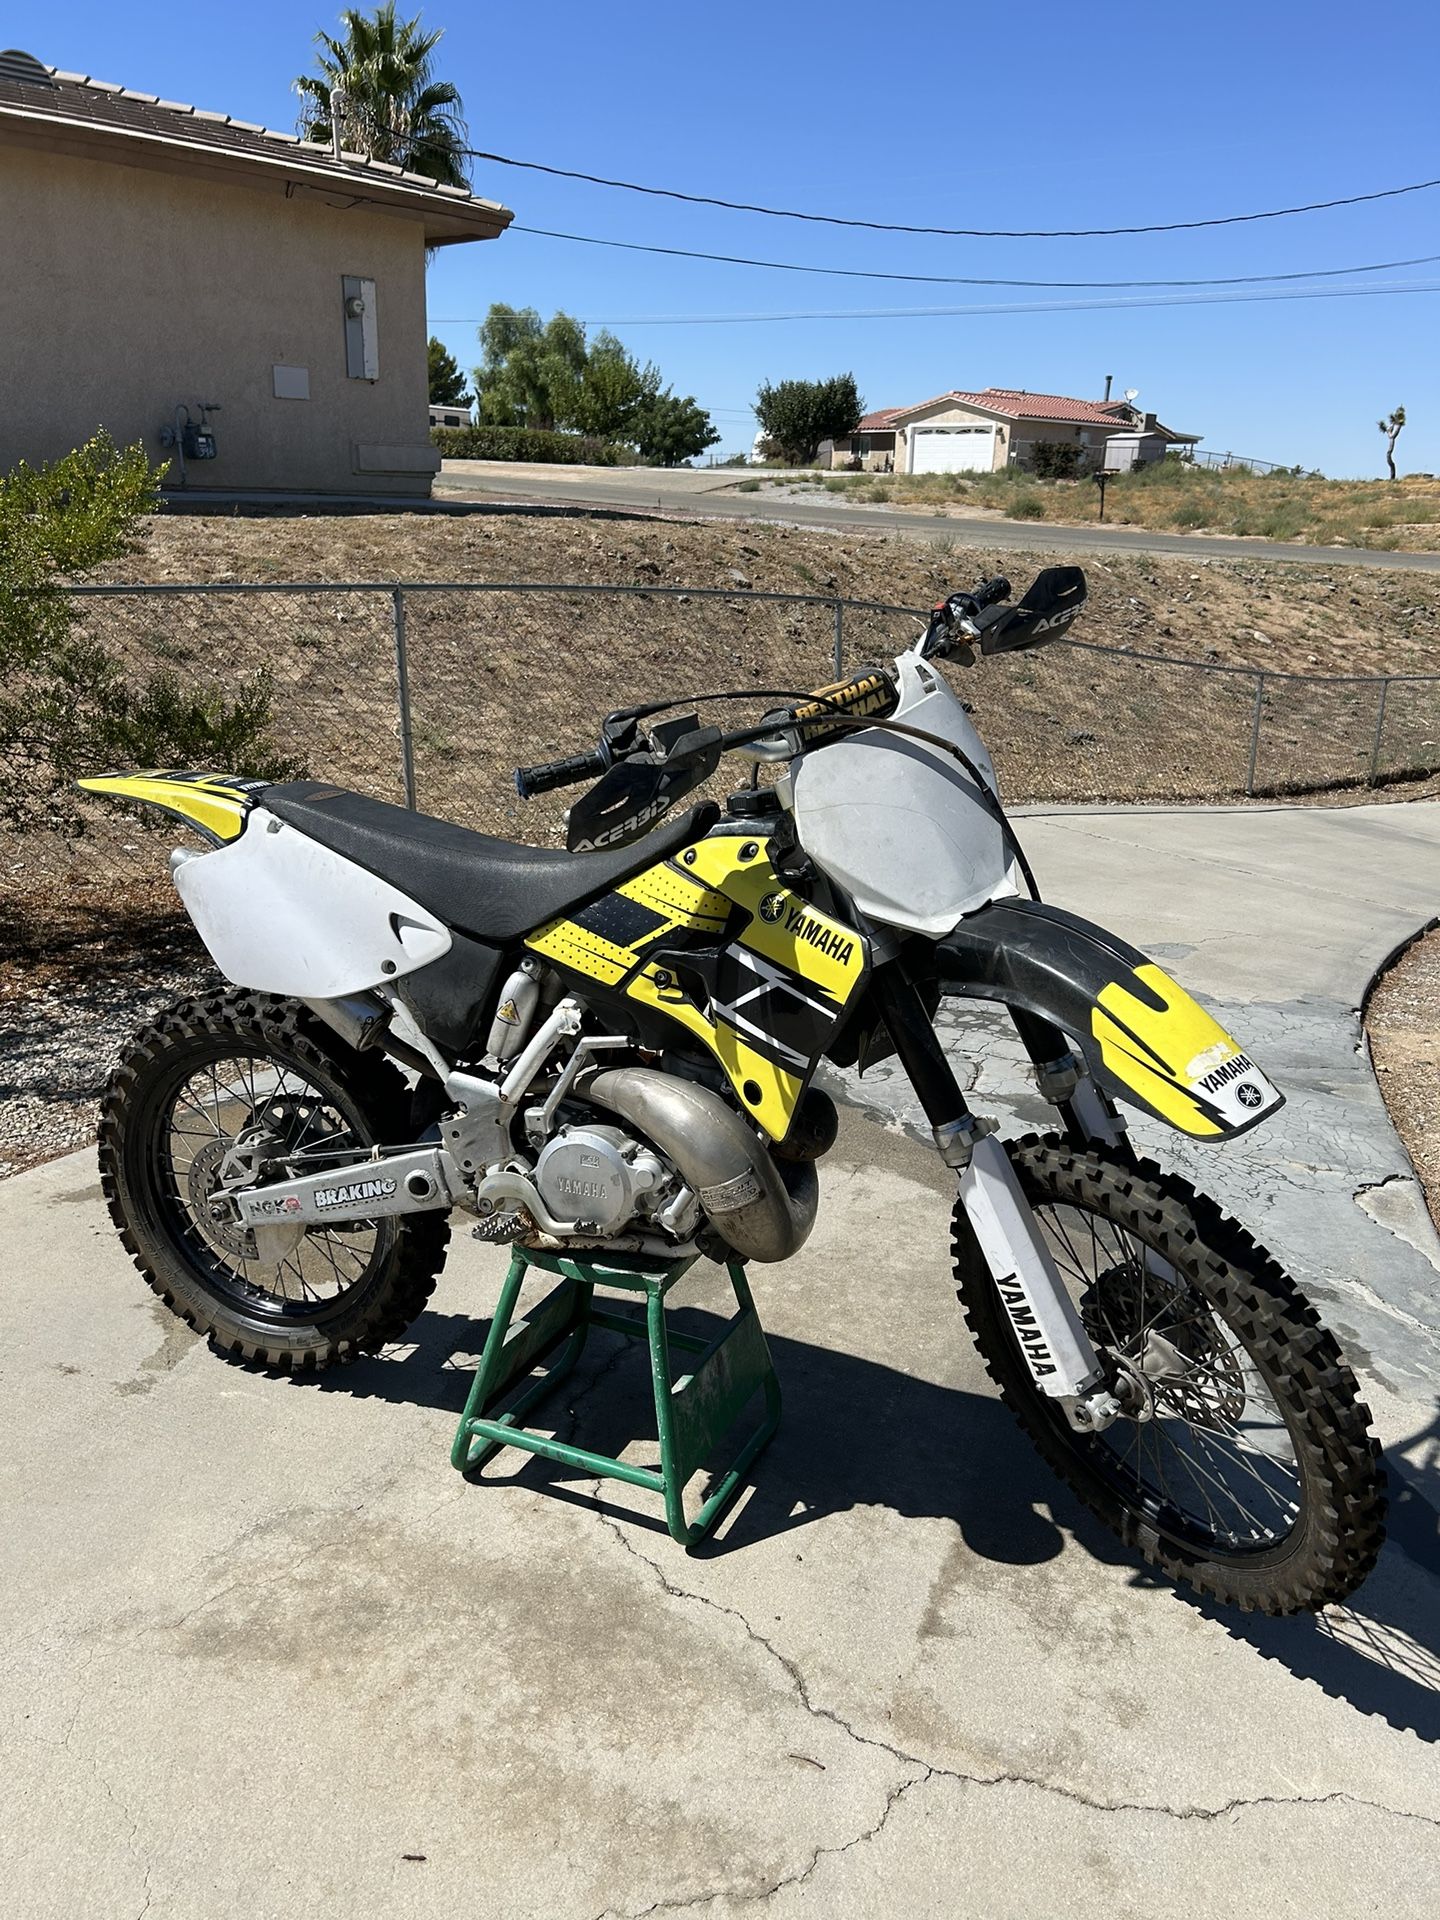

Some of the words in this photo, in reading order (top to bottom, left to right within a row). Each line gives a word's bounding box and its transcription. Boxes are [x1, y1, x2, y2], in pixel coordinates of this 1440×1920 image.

[784, 907, 854, 966] YAMAHA
[1198, 1054, 1254, 1094] YAMAHA
[314, 1178, 397, 1208] BRAKING
[557, 1177, 608, 1199] YAMAHA
[996, 1272, 1057, 1376] YAMAHA
